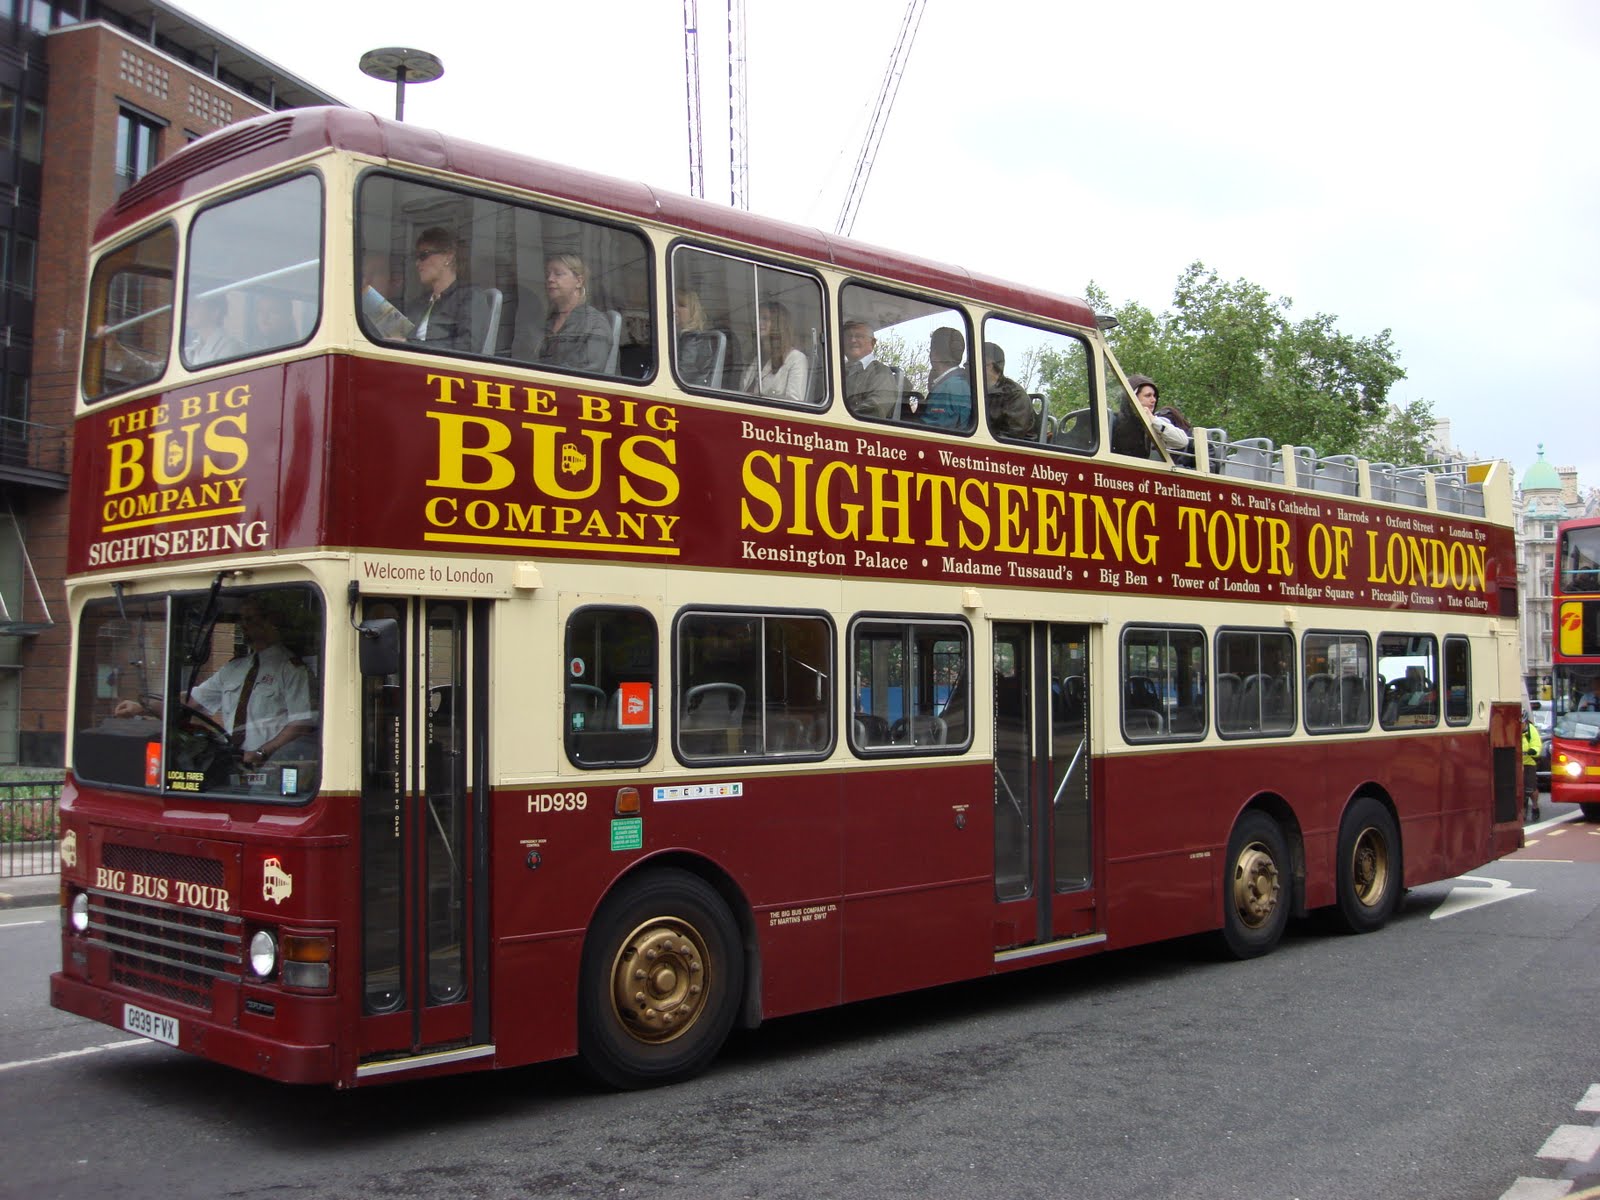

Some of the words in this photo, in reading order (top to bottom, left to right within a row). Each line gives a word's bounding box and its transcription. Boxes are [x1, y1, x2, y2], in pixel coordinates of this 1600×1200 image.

[108, 403, 170, 437] THE
[181, 384, 252, 419] BIG
[427, 374, 558, 416] THE
[577, 394, 680, 432] BIG
[104, 412, 249, 497] BUS
[426, 411, 680, 507] BUS
[102, 478, 248, 521] COMPANY
[741, 421, 849, 453] Buckingham
[856, 438, 907, 461] Palace
[938, 450, 1025, 477] Westminster
[1031, 463, 1068, 485] Abbey
[1093, 472, 1134, 492] Houses
[1138, 480, 1150, 493] of
[1154, 481, 1211, 502] Parliament
[1231, 492, 1245, 507] St.
[1248, 495, 1276, 511] Paul's
[1278, 500, 1320, 517] Cathedral
[1337, 508, 1369, 523] Harrods
[1386, 515, 1411, 531] Oxford
[1413, 519, 1434, 533] Street
[1449, 526, 1473, 539] London
[1475, 529, 1486, 542] Eye
[425, 497, 680, 542] COMPANY
[741, 449, 1160, 566] SIGHTSEEING
[1178, 506, 1294, 576] TOUR
[1308, 522, 1353, 580] OF
[1366, 530, 1486, 592] LONDON
[88, 521, 269, 566] SIGHTSEEING
[364, 561, 425, 581] Welcome
[430, 566, 442, 581] to
[446, 566, 493, 584] London
[742, 540, 847, 567] Kensington
[854, 550, 908, 570] Palace
[941, 556, 1002, 576] Madame
[1007, 562, 1073, 581] Tussaud's
[1100, 568, 1119, 586] Big
[1125, 570, 1148, 585] Ben
[1171, 574, 1204, 589] Tower
[1208, 577, 1219, 590] of
[1224, 578, 1260, 593] London
[1279, 582, 1322, 600] Trafalgar
[1325, 585, 1354, 601] Square
[1371, 589, 1408, 605] Piccadilly
[1411, 592, 1434, 605] Circus
[1447, 595, 1462, 607] Tate
[1465, 597, 1488, 610] Gallery
[168, 771, 185, 780] LOCAL
[186, 772, 204, 781] FARES
[172, 781, 200, 791] AVAILABLE
[527, 792, 588, 813] HD939
[96, 867, 125, 892] BIG
[132, 873, 168, 900] BUS
[175, 881, 230, 912] TOUR
[803, 906, 827, 914] COMPANY
[128, 1008, 151, 1032] G939
[154, 1017, 174, 1040] FVX
